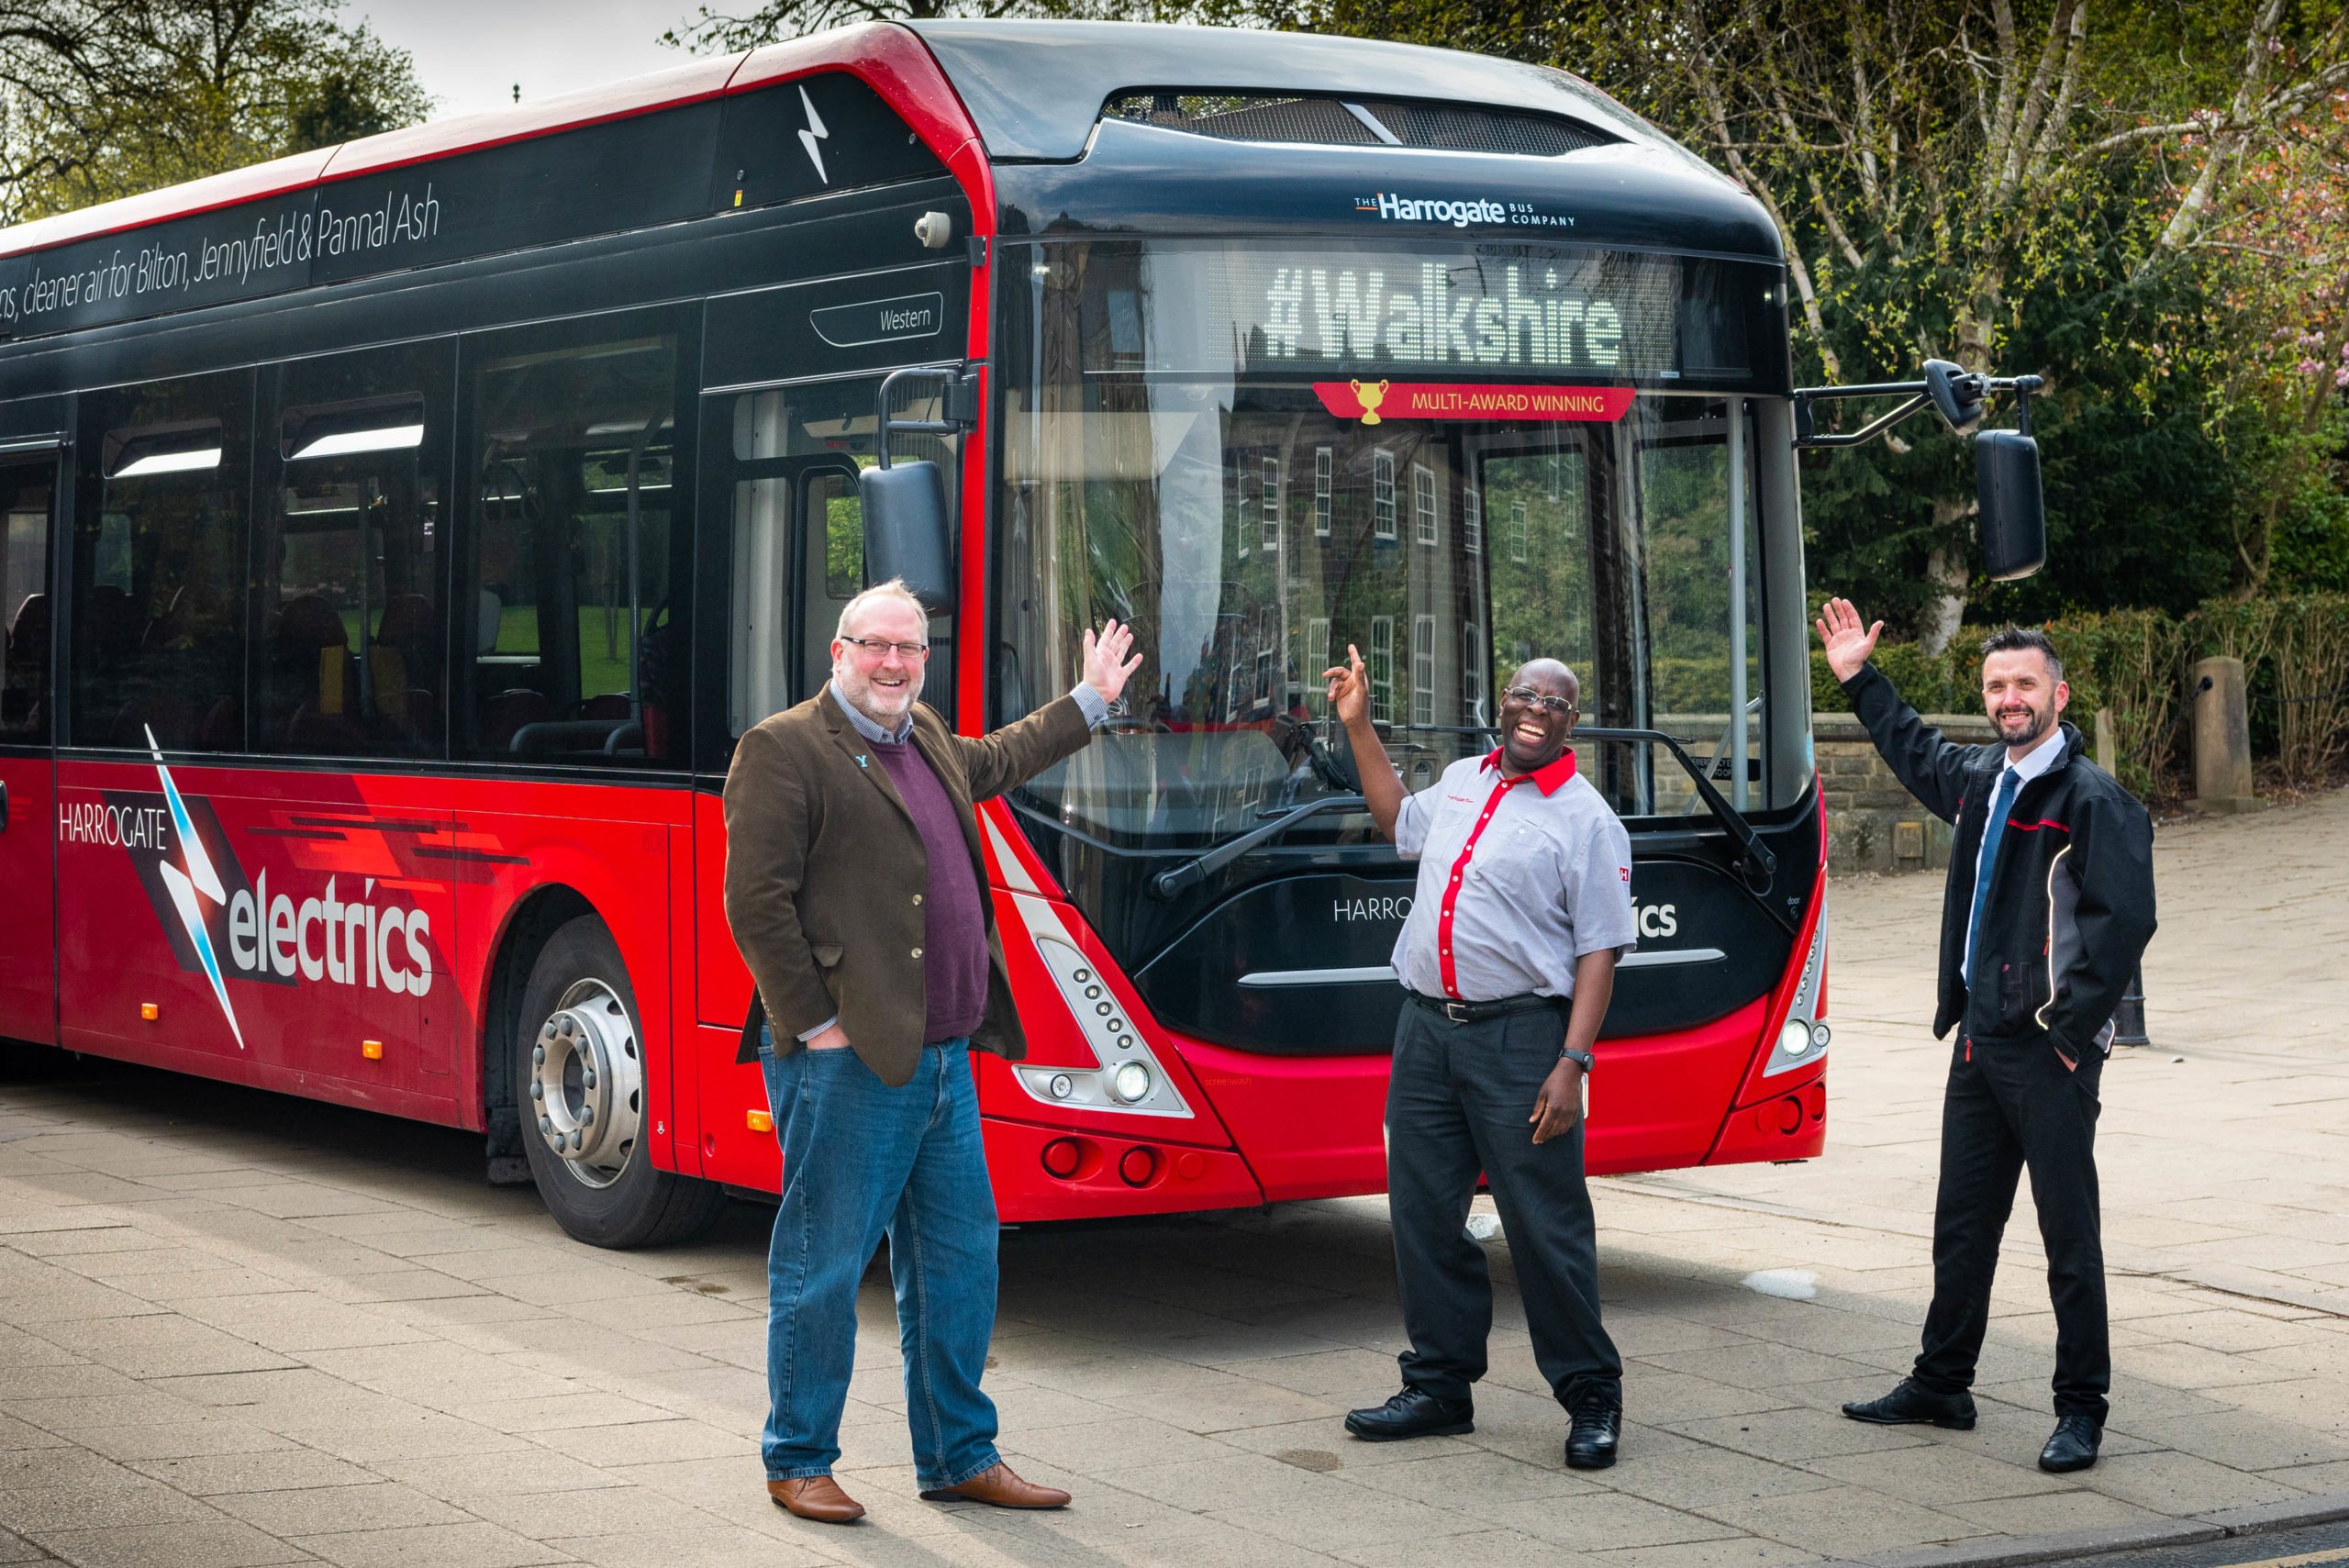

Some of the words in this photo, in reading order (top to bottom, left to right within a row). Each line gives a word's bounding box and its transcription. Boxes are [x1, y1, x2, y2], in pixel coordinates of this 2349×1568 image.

[1353, 197, 1377, 207] THE
[1377, 193, 1506, 228] Harrogate
[1509, 203, 1533, 213] BUS
[1512, 215, 1575, 227] COMPANY
[23, 267, 84, 315] cleaner
[84, 260, 108, 303] air
[108, 250, 136, 298] for
[137, 241, 190, 292] Bilton,
[194, 211, 296, 285] Jennyfield
[296, 214, 312, 261] &
[317, 191, 392, 255] Pannal
[393, 183, 440, 243] Ash
[880, 308, 930, 331] Western
[1264, 262, 1622, 365] #Walkshire
[1411, 393, 1530, 411] MULTI-AWARD
[1531, 395, 1605, 413] WINNING
[59, 803, 167, 850] HARROGATE
[1334, 896, 1413, 922] HARRO
[228, 866, 432, 996] electrics
